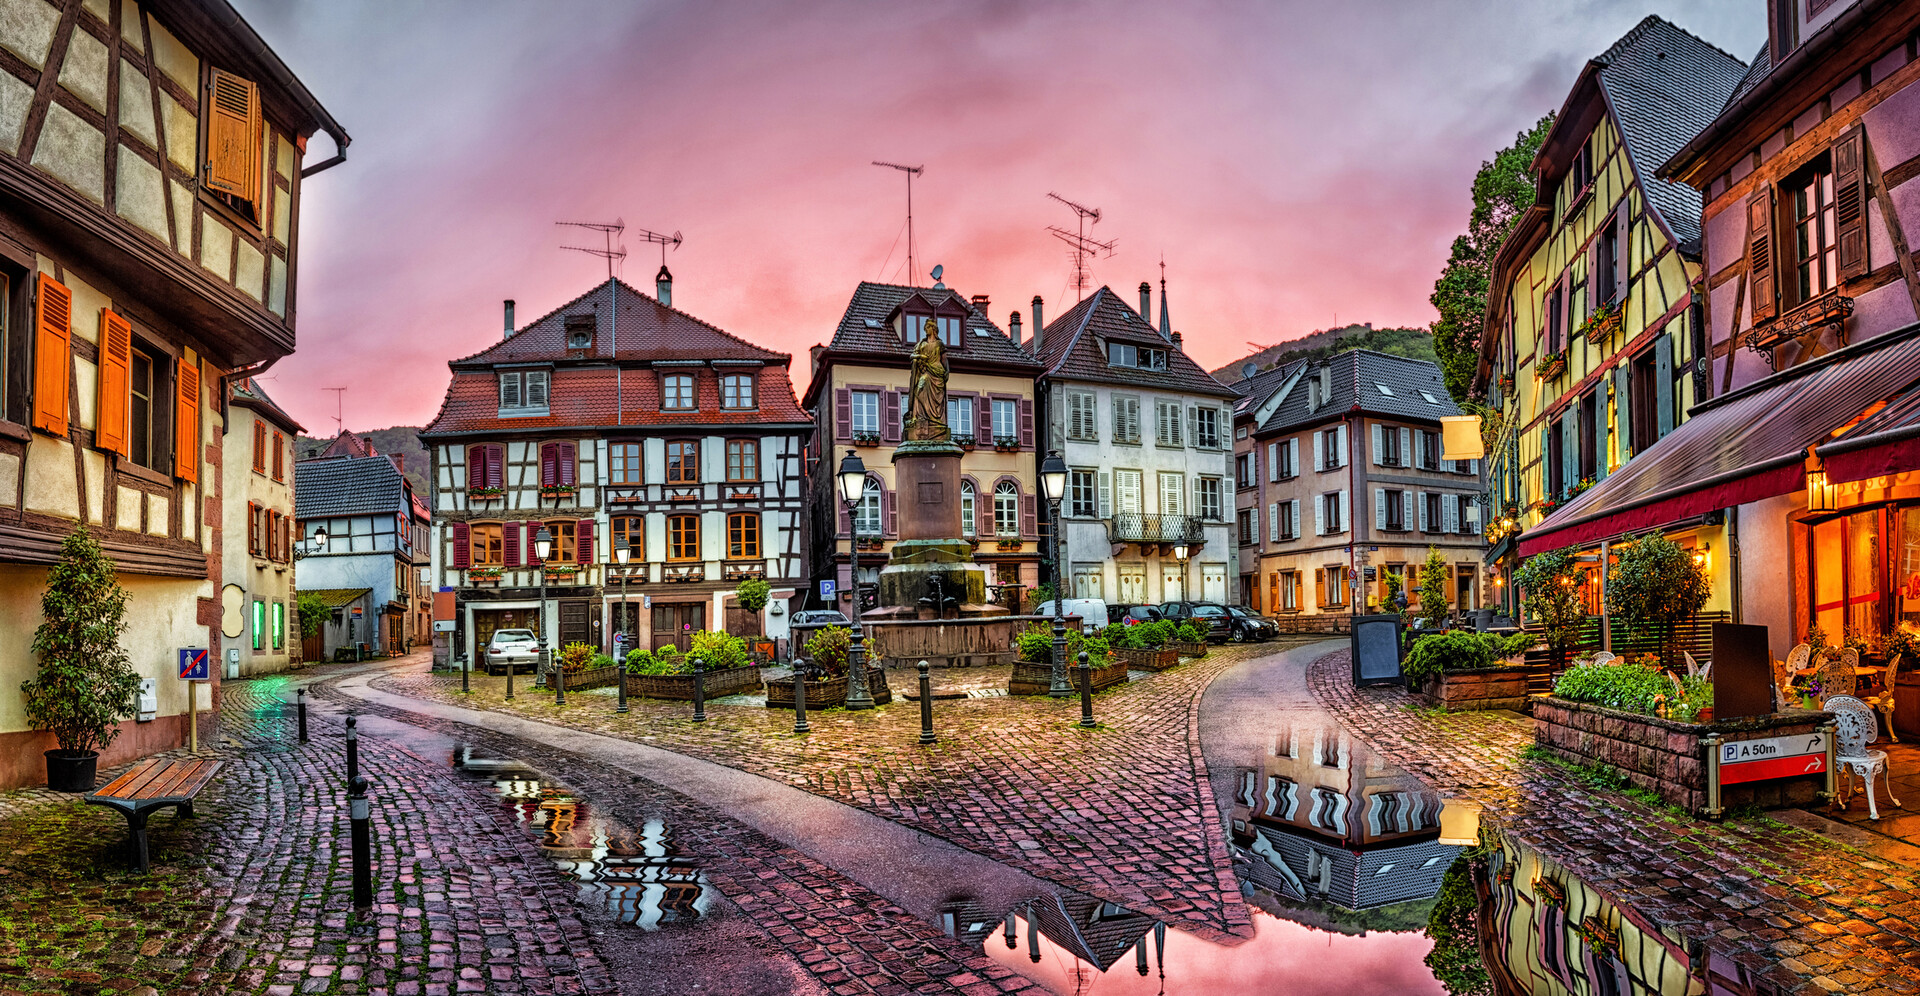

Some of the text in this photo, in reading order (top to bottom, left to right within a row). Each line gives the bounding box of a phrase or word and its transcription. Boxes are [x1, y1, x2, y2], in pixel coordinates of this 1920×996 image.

[825, 583, 831, 593] P
[1726, 744, 1776, 759] P A 50m
